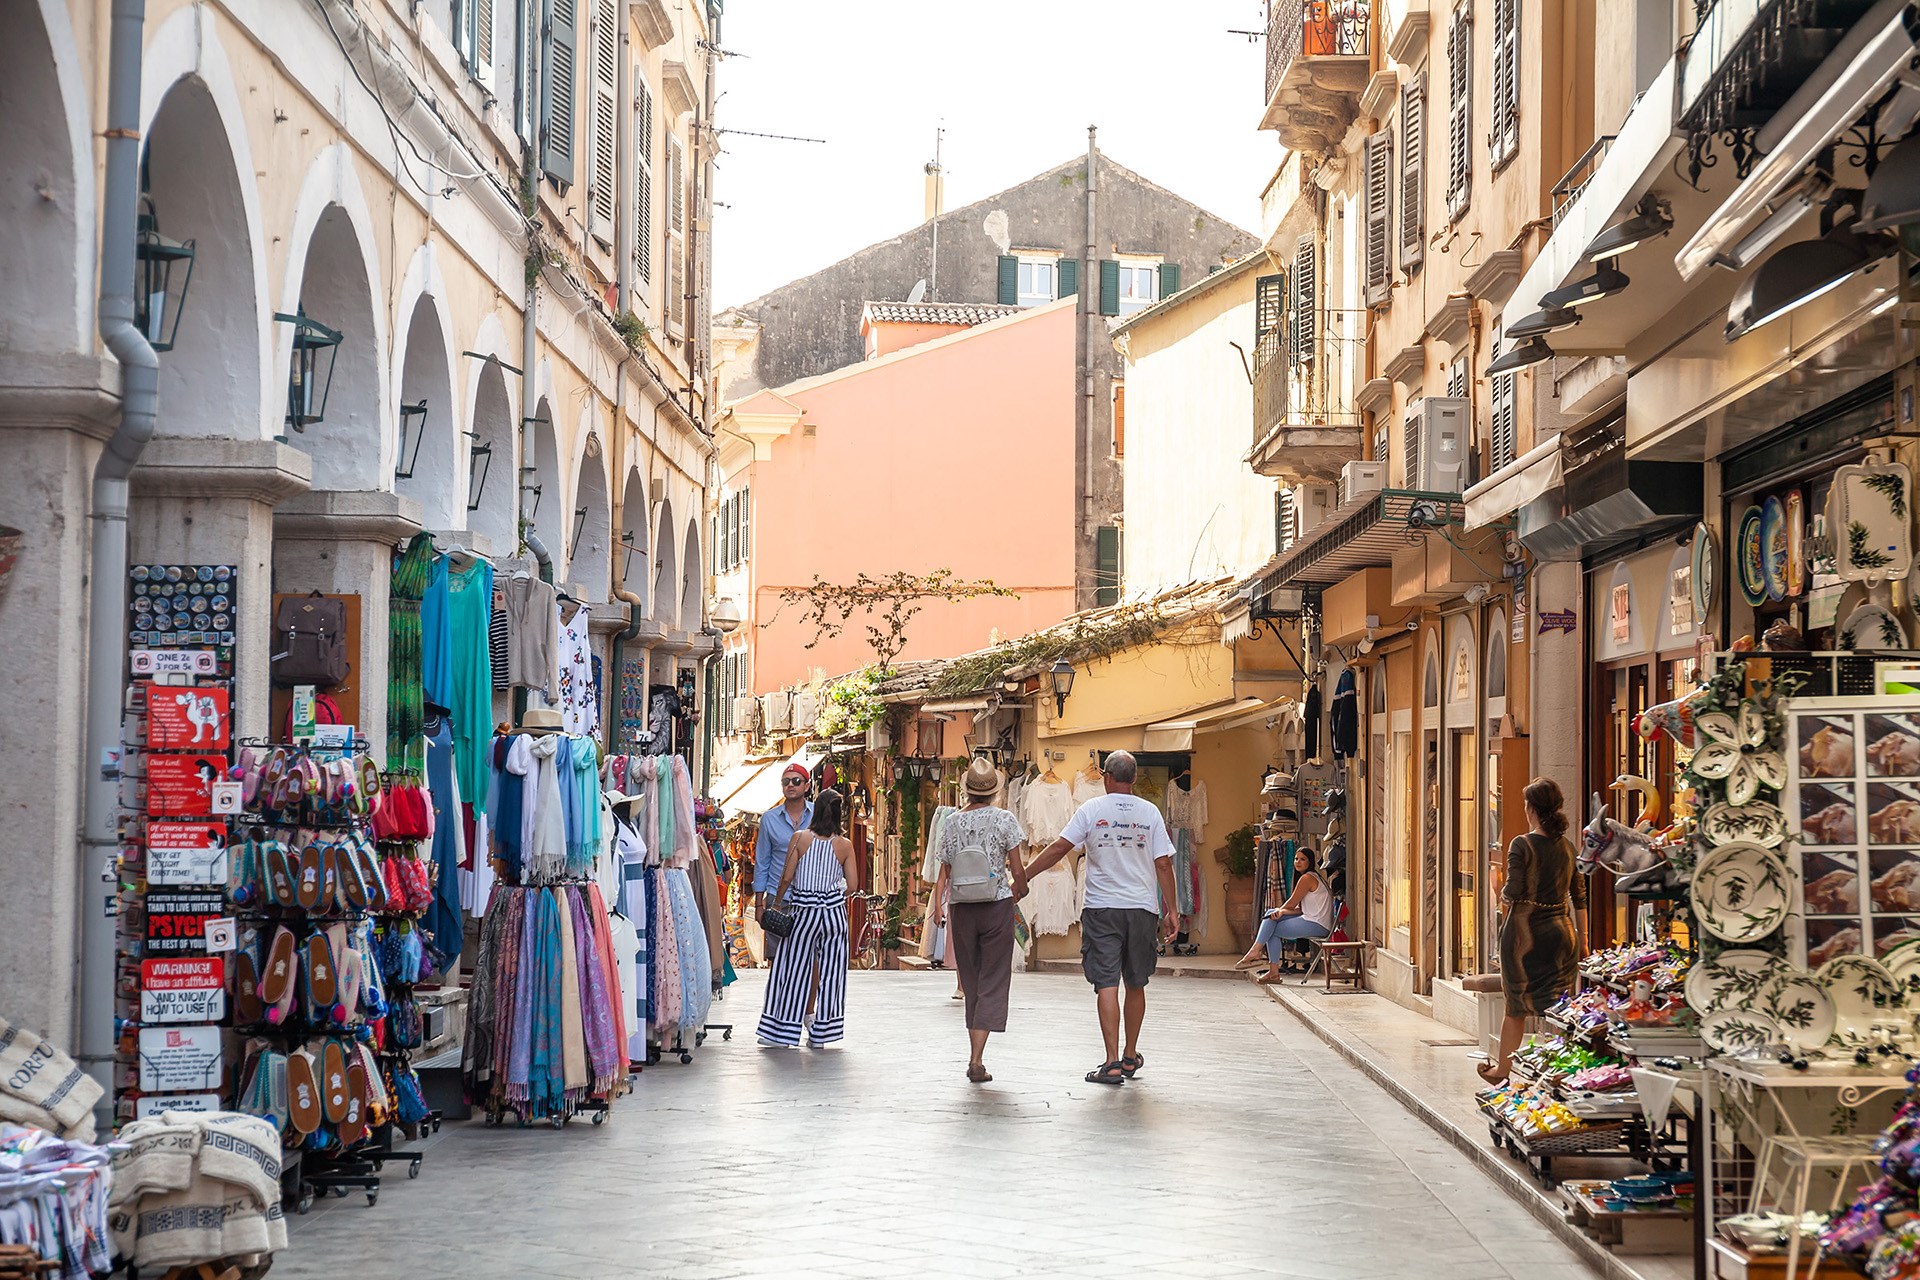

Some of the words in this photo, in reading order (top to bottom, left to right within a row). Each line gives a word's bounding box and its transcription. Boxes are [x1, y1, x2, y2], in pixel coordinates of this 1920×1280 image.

[148, 903, 165, 912] THAN
[166, 903, 175, 912] TO
[176, 903, 189, 911] LIVE
[191, 903, 208, 911] WITH
[210, 903, 222, 911] THE
[149, 914, 221, 937] PSYCH
[148, 940, 160, 949] THE
[162, 940, 178, 949] REST
[180, 940, 188, 949] OF
[151, 963, 211, 975] WARNING!
[146, 978, 149, 988] I
[150, 978, 170, 988] have
[172, 979, 183, 987] an
[185, 976, 218, 987] attitude
[157, 993, 176, 1002] AND
[178, 992, 207, 1002] KNOW
[146, 1004, 169, 1015] HOW
[172, 1004, 184, 1014] TO
[186, 1003, 205, 1013] USE
[8, 1041, 53, 1089] CORFU
